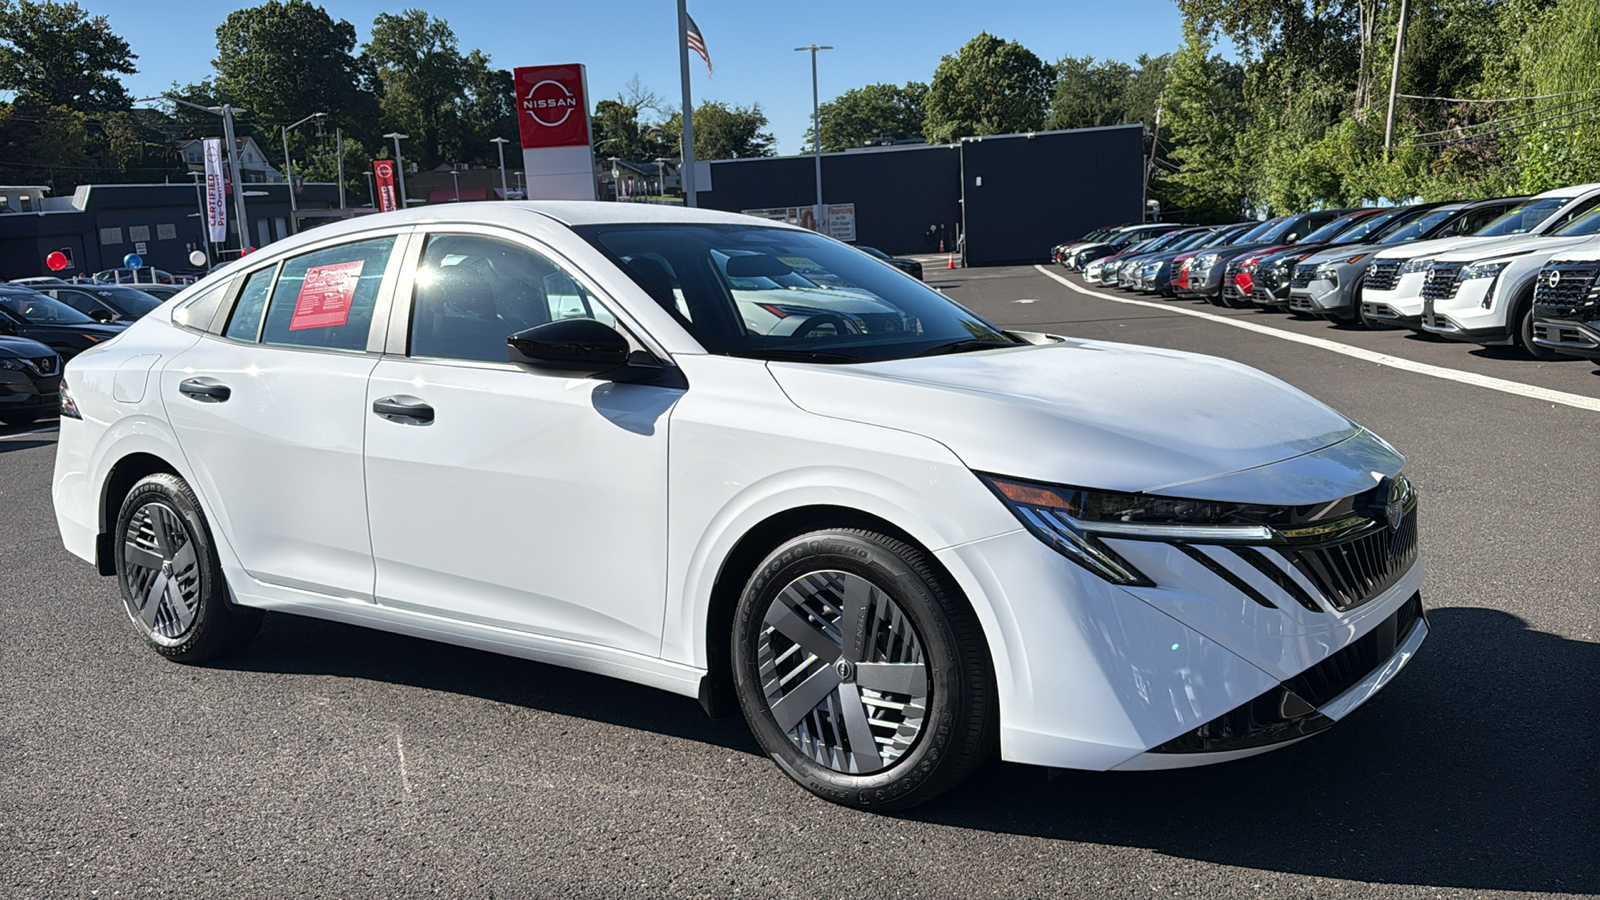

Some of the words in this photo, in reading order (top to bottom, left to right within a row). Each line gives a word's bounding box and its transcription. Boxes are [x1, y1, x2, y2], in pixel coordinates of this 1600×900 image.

[523, 97, 576, 109] NISSAN
[207, 173, 216, 227] CERTIFIED
[215, 174, 225, 227] Pre-Owned
